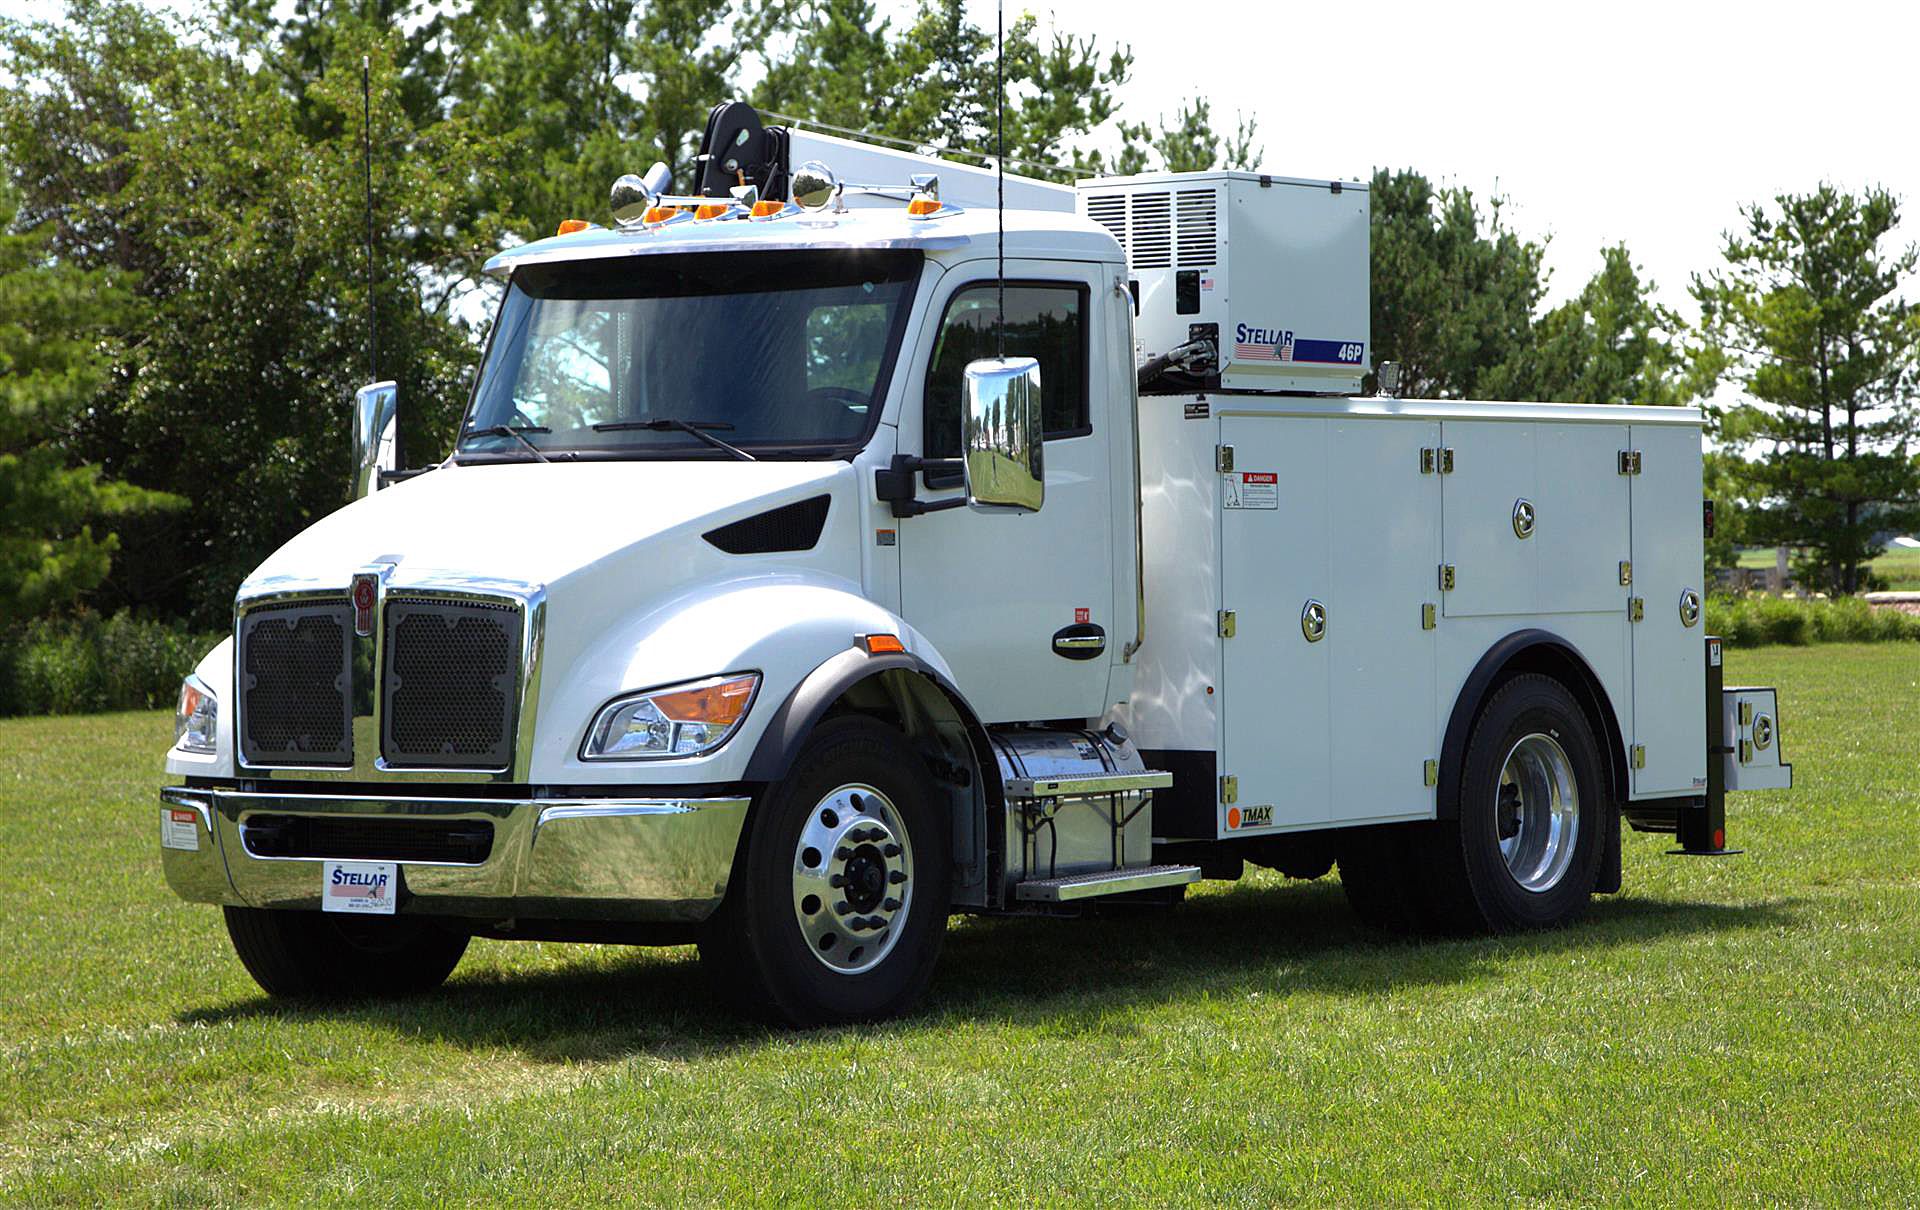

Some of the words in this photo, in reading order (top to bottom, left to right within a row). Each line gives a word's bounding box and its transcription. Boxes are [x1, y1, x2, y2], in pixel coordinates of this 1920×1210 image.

[1235, 323, 1293, 346] STELLAR
[1338, 343, 1362, 361] 46P
[1242, 807, 1272, 822] TMAX
[331, 869, 388, 886] STELLAR
